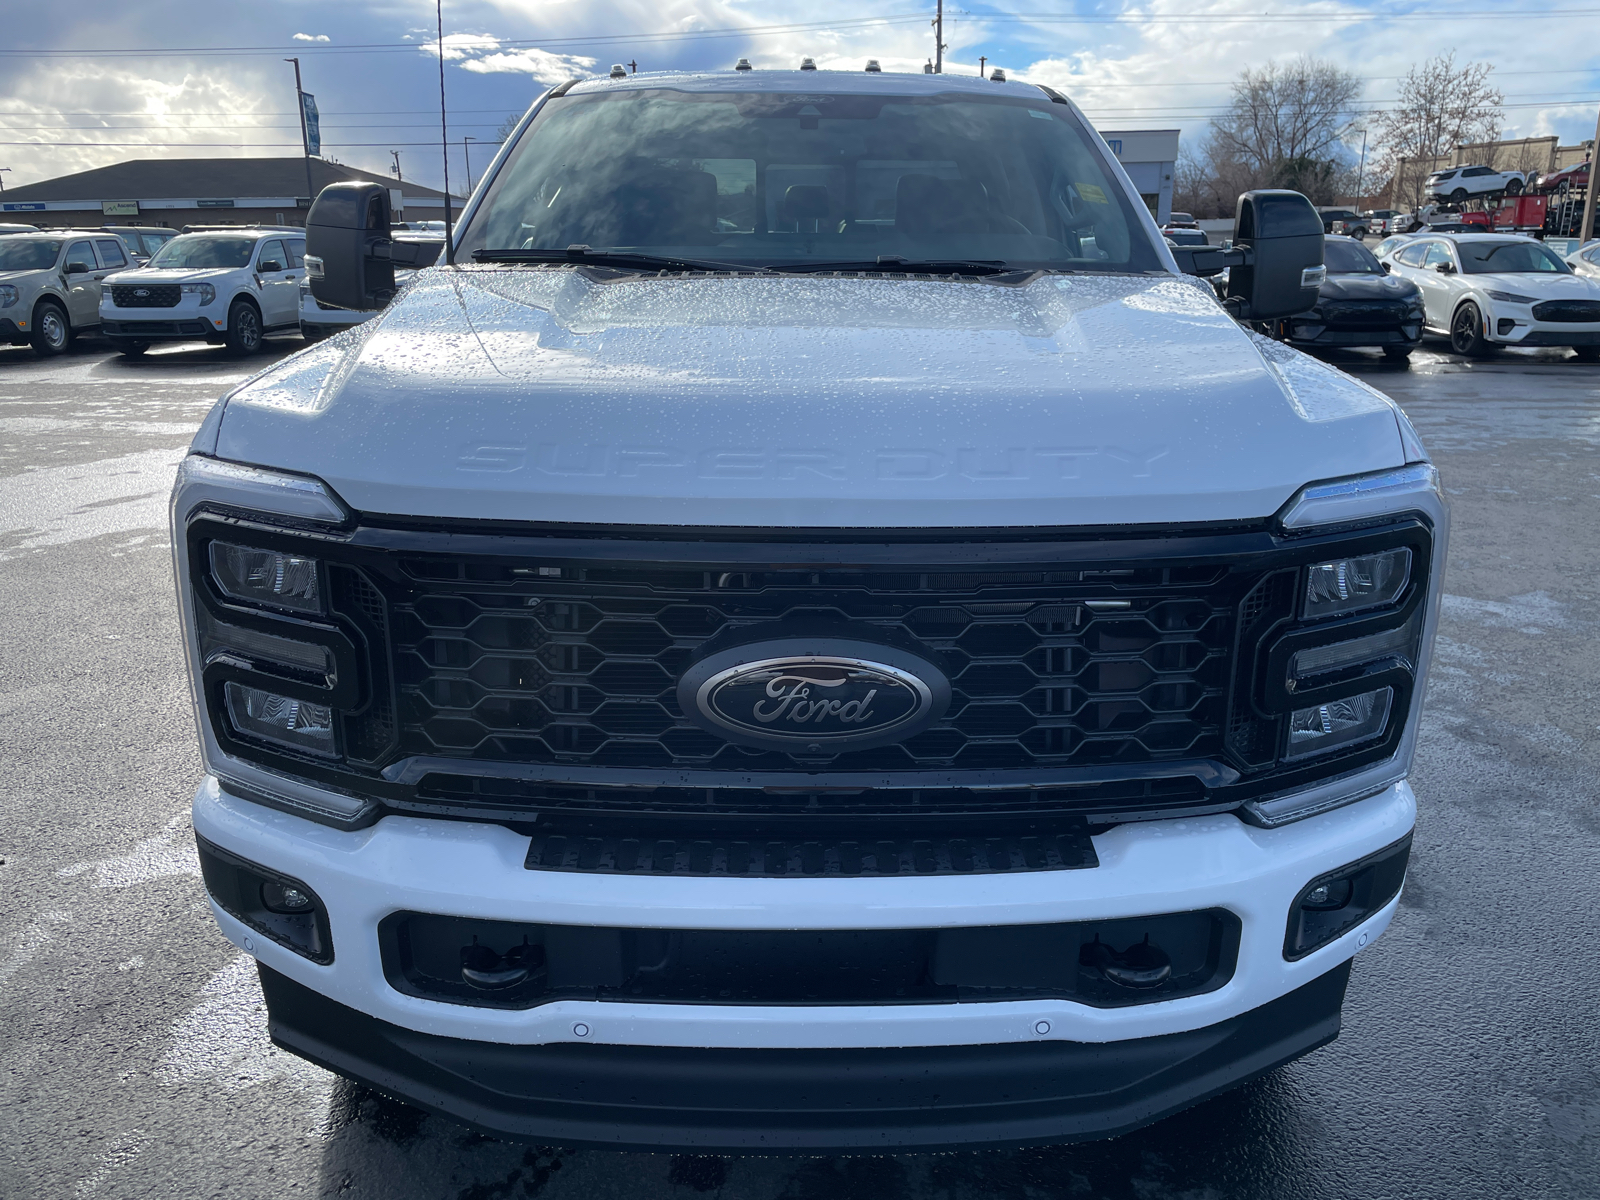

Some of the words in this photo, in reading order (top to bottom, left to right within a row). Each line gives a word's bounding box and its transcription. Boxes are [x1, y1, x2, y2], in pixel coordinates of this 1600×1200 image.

[455, 440, 847, 482] SUPER
[875, 444, 1169, 481] DUTY
[752, 675, 877, 723] Ford
